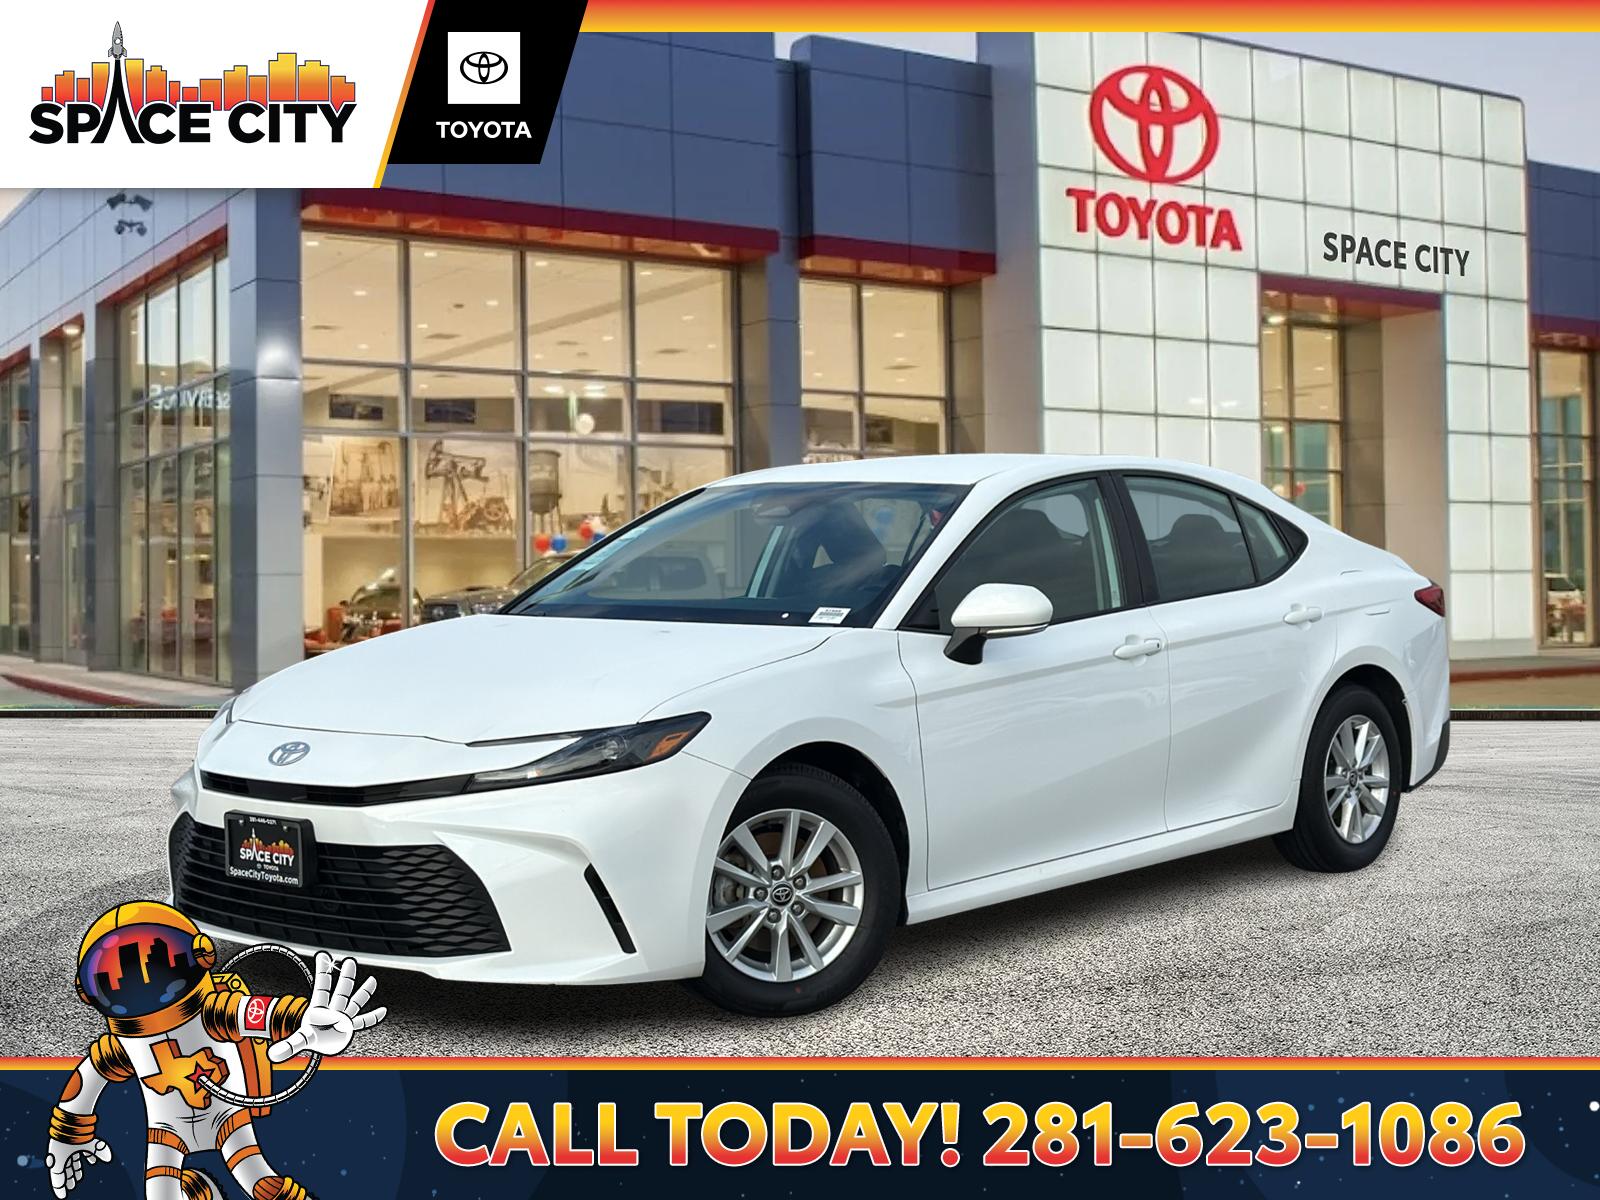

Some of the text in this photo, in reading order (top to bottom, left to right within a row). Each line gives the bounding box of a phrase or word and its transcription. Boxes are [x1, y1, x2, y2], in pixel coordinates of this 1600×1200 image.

[1066, 188, 1242, 251] TOYOTA
[1323, 232, 1470, 277] SPACE CITY
[239, 847, 295, 866] SPACE CITY
[229, 866, 299, 885] SpaceCityToyota.com
